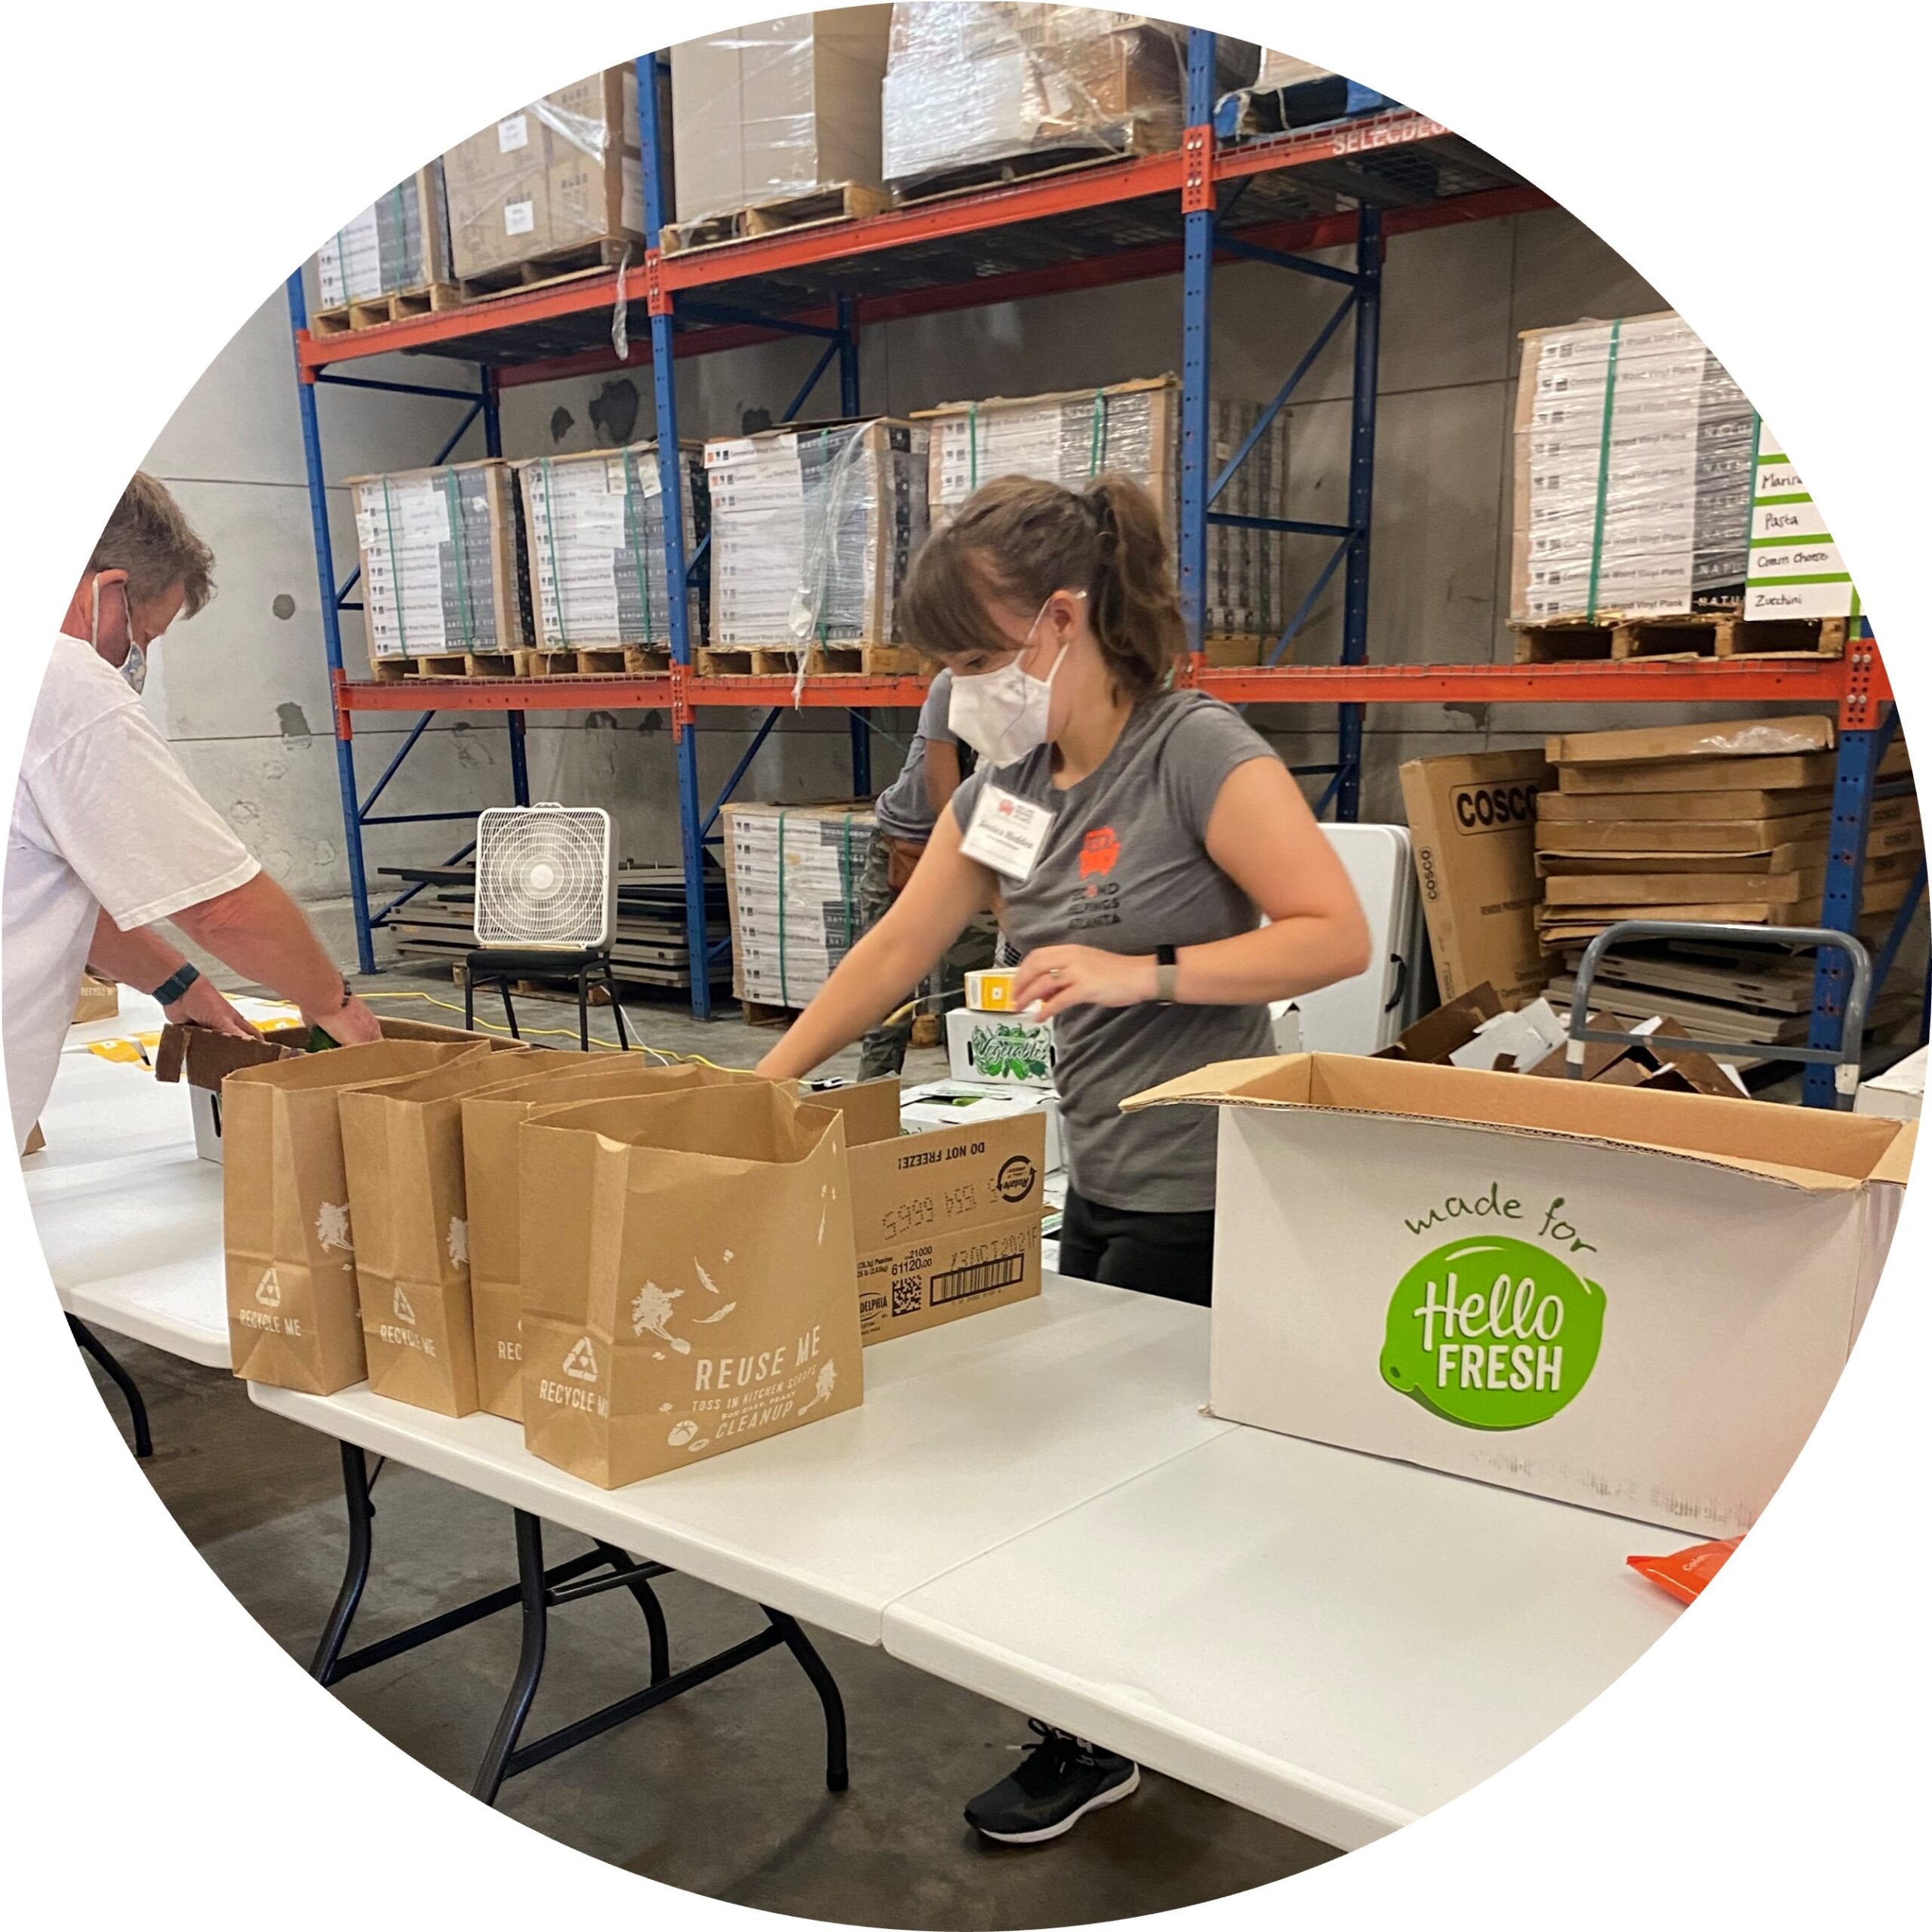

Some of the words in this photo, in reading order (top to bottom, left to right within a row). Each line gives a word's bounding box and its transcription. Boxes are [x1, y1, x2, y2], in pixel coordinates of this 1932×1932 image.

[1765, 513, 1799, 530] Pasta
[1755, 595, 1802, 607] Zucchini
[1421, 850, 1437, 900] COSCO
[980, 1037, 1048, 1063] Vegetables
[898, 1150, 942, 1170] FREEZE!
[945, 1146, 966, 1160] NOT
[971, 1142, 985, 1155] DO
[1404, 1181, 1524, 1235] made
[1537, 1196, 1597, 1253] for
[909, 1245, 933, 1259] 21000
[860, 1296, 888, 1313] DELPHIA
[1414, 1272, 1564, 1352] Hello
[239, 1309, 281, 1334] RECYCLE
[284, 1318, 301, 1337] ME
[380, 1324, 421, 1350] RECYCLE
[695, 1346, 786, 1391] REUSE
[796, 1324, 820, 1367] ME
[1438, 1343, 1563, 1392] FRESH
[539, 1380, 594, 1412] RECYCLE
[692, 1398, 721, 1411] TOSS
[727, 1397, 740, 1409] IN
[743, 1382, 784, 1404] KITCHEN
[787, 1364, 817, 1389] SCRAPS
[715, 1400, 794, 1439] CLEANUP
[721, 1410, 740, 1420] FOR
